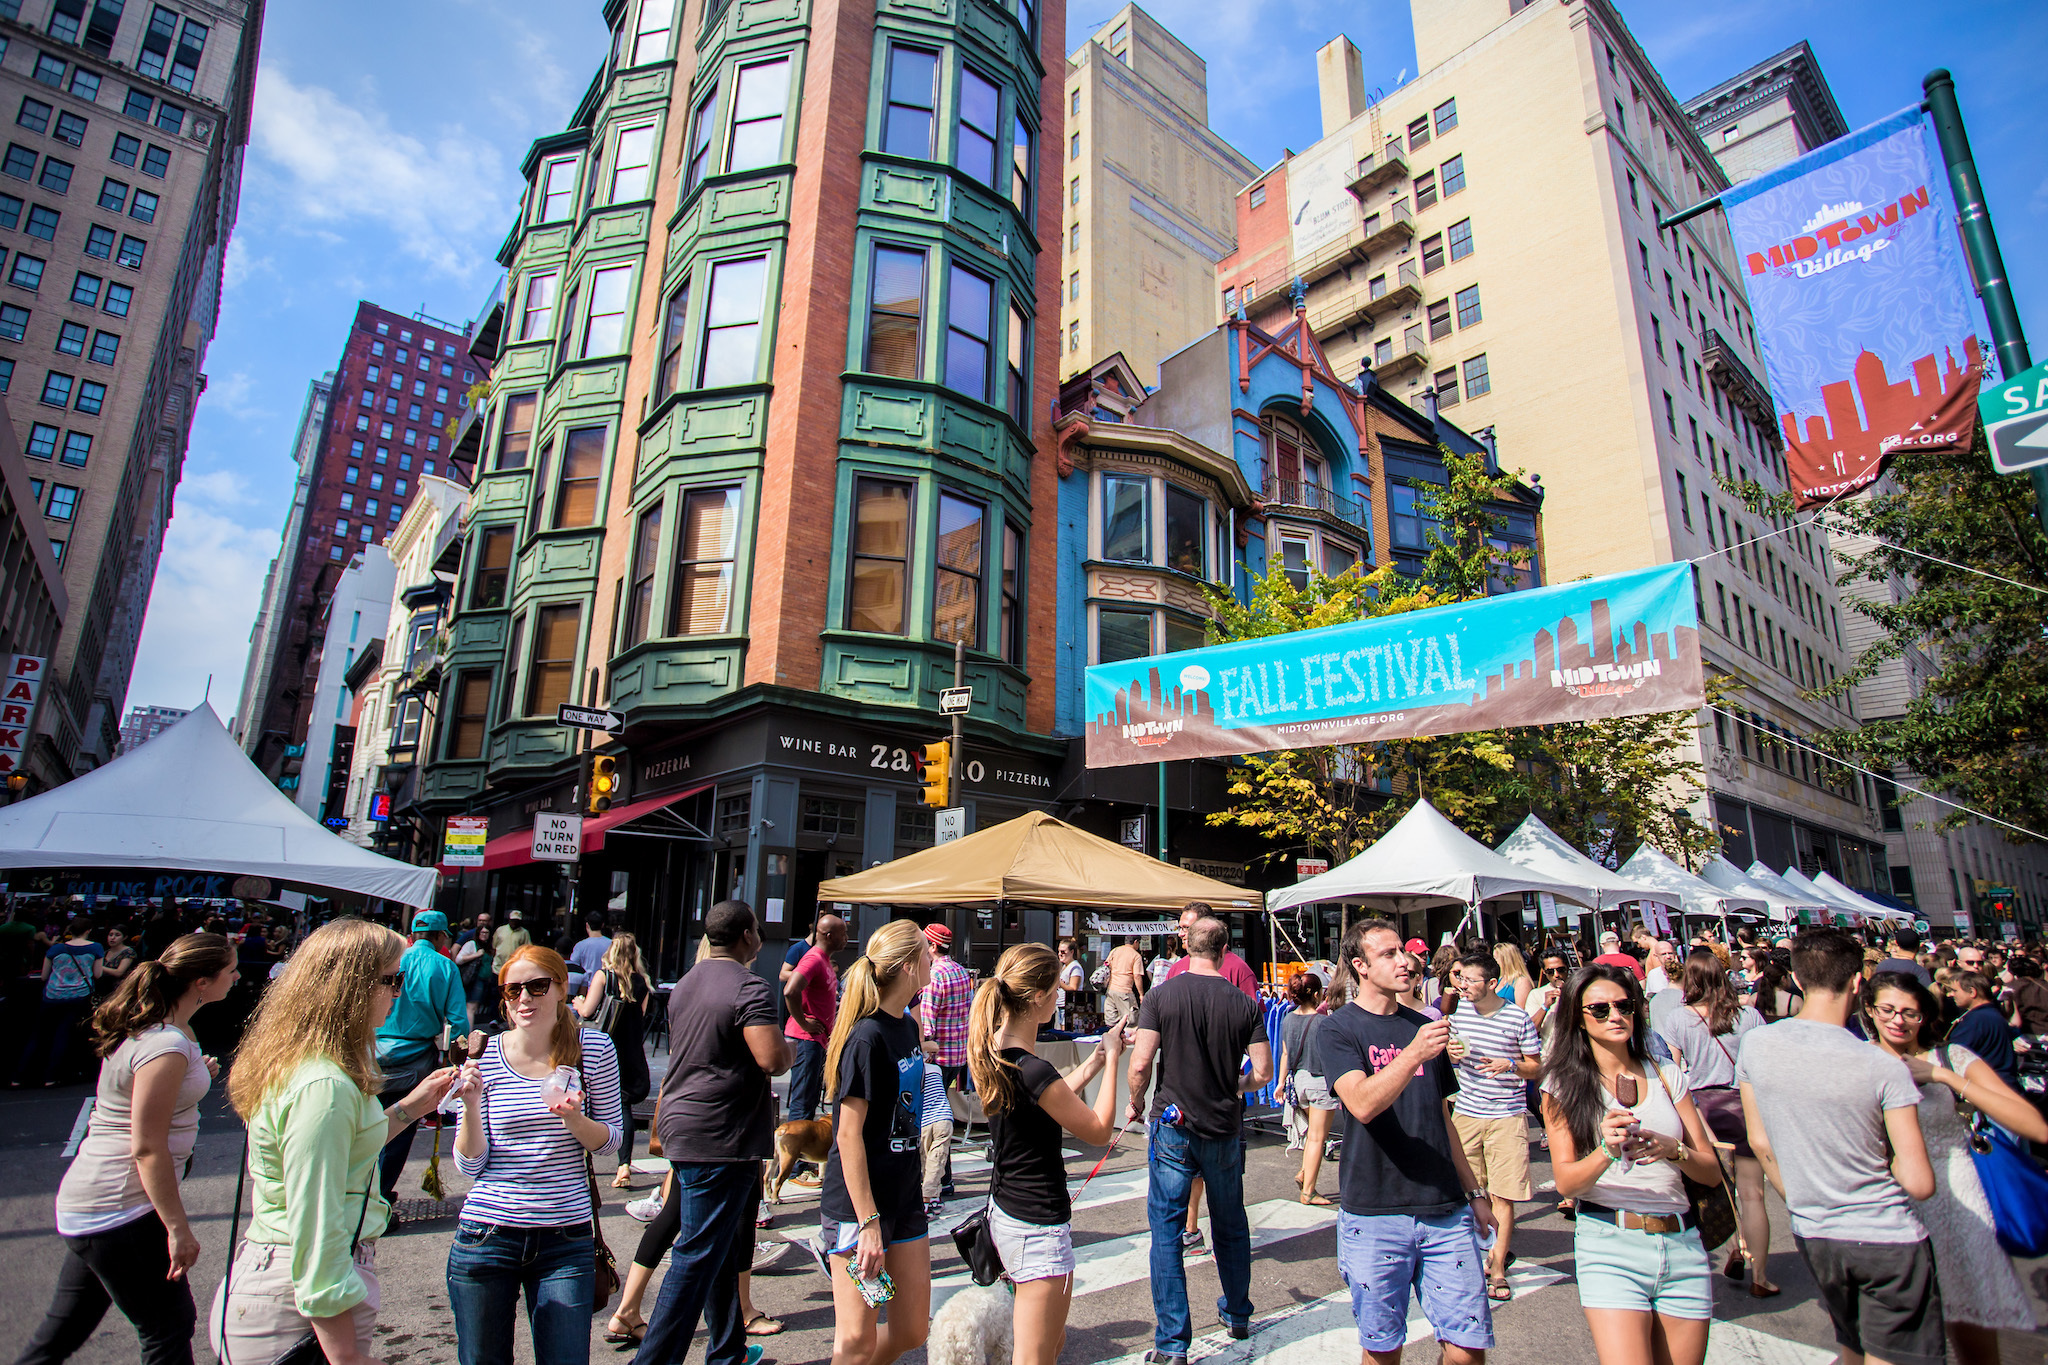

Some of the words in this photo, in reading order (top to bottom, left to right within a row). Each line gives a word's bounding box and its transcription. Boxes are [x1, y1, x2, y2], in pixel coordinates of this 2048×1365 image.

[1313, 209, 1331, 225] BLUM
[1332, 196, 1353, 214] STORE
[1746, 185, 1929, 276] MIDTOWN
[1792, 239, 1890, 279] Village
[1183, 673, 1207, 682] WELCOME!
[1219, 659, 1298, 720] FALL
[1300, 632, 1476, 711] FESTIVAL
[1550, 659, 1661, 688] MIDTOWN
[1577, 682, 1635, 698] Village
[0, 658, 40, 749] PARK
[947, 697, 955, 706] ONE
[956, 695, 966, 704] WAY
[565, 711, 583, 722] ONE
[587, 715, 606, 725] WAY
[1277, 712, 1405, 734] MIDTOWNVILLAGE.ORG
[1122, 719, 1184, 739] MIDTOWN
[1137, 734, 1168, 747] Village
[645, 755, 691, 780] PIZZERIA
[780, 736, 822, 753] WINE
[828, 744, 858, 758] BAR
[996, 770, 1050, 788] PIZZERIA
[551, 820, 567, 829] NO
[944, 816, 955, 826] NO
[543, 831, 574, 842] TURN
[941, 832, 958, 842] TURN
[536, 844, 551, 853] ON
[555, 845, 577, 854] RED
[67, 881, 146, 896] ROLLING
[154, 876, 225, 897] ROCK
[1107, 923, 1125, 932] DUKE
[1128, 924, 1133, 932] &
[1135, 922, 1169, 932] WINSTON
